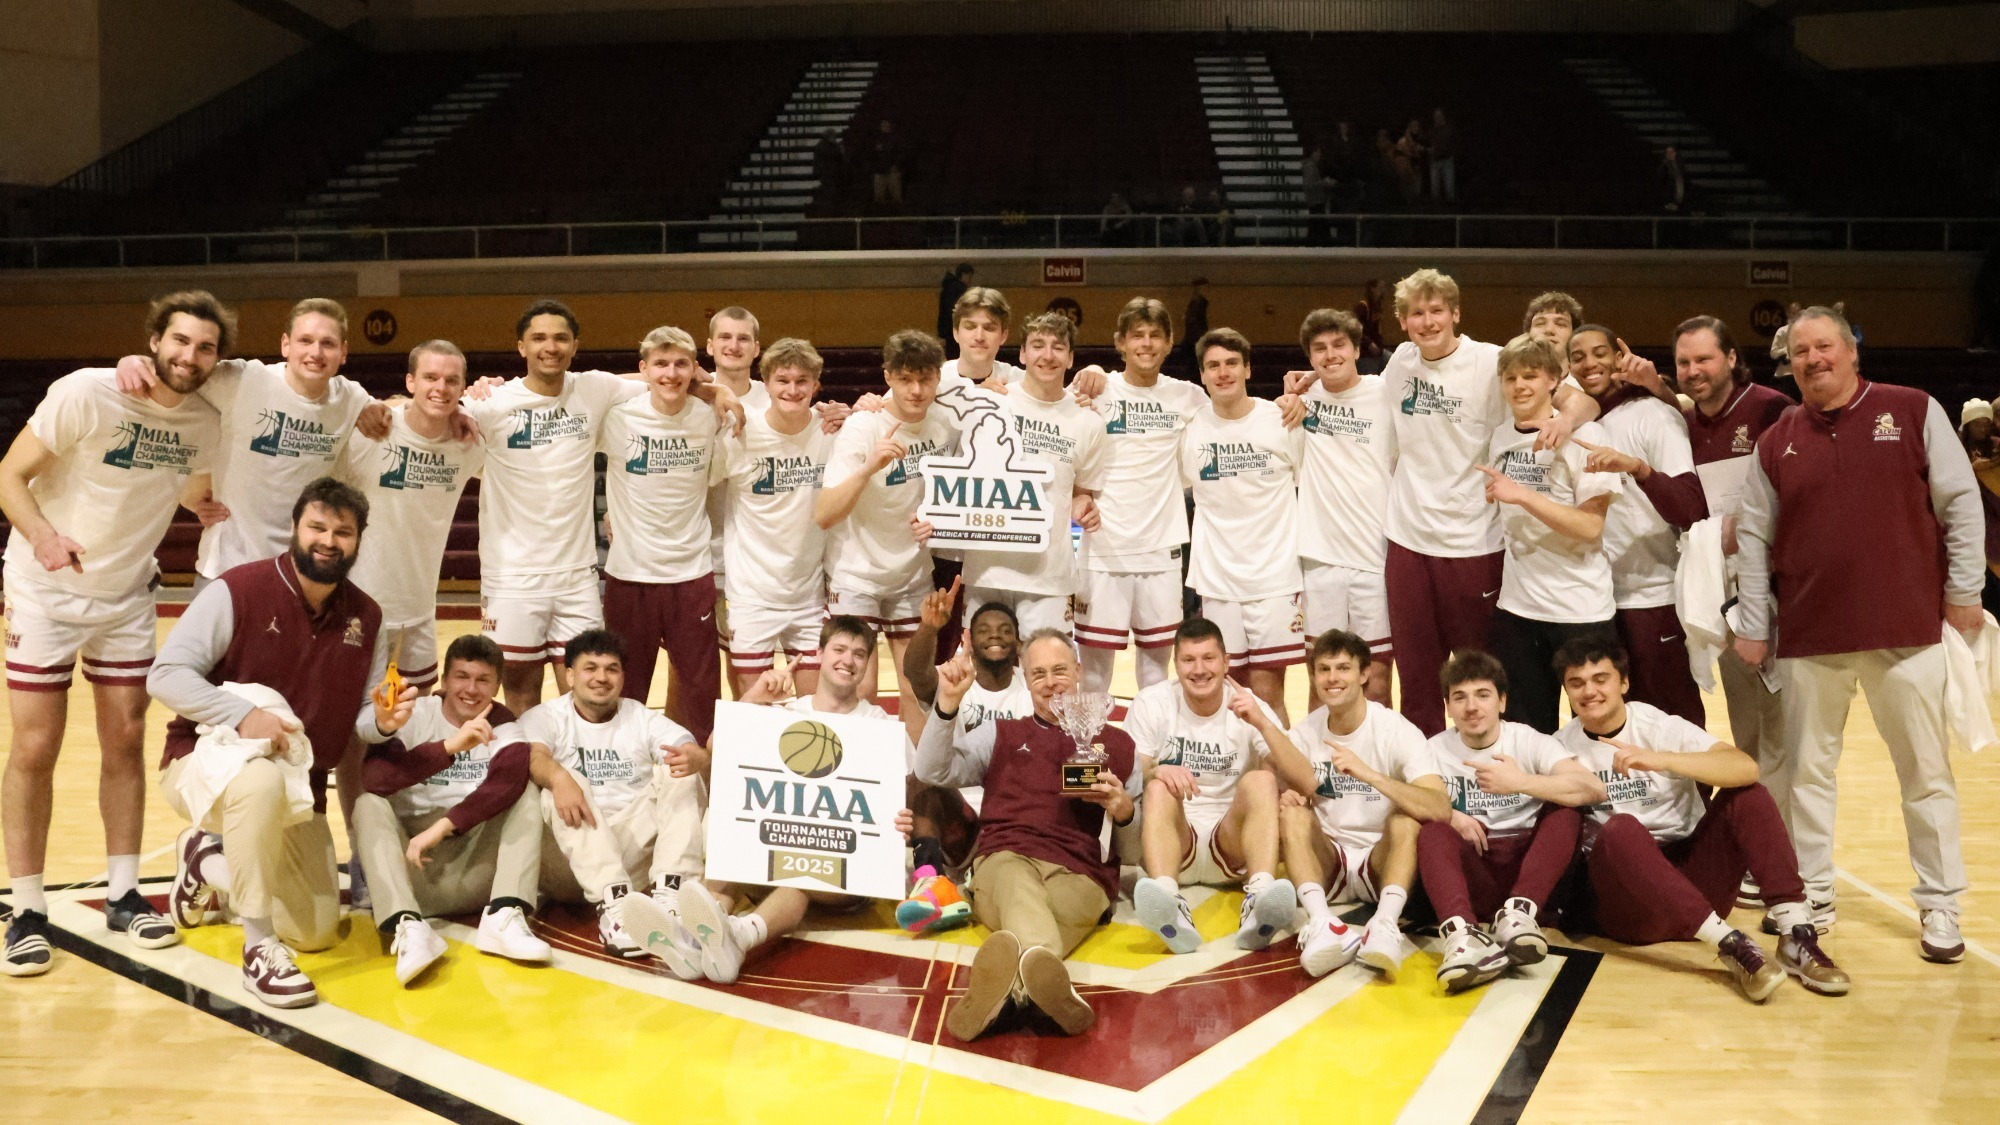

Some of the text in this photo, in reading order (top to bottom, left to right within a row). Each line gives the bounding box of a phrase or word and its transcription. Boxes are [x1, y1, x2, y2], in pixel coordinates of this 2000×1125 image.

[1046, 265, 1080, 277] Calvin
[1753, 267, 1786, 279] Calvin
[1754, 309, 1782, 326] 106
[366, 319, 393, 335] 104
[1127, 402, 1163, 413] MIAA
[1320, 404, 1355, 418] MIAA
[534, 408, 569, 421] MIAA
[1127, 413, 1179, 421] TOURNAMENT
[285, 417, 323, 434] MIAA
[533, 416, 588, 430] TOURNAMENT
[1024, 419, 1060, 436] MIAA
[1127, 420, 1174, 428] CHAMPIONS
[1319, 414, 1372, 429] TOURNAMENT
[140, 427, 180, 445] MIAA
[284, 431, 340, 444] TOURNAMENT
[533, 425, 583, 438] CHAMPIONS
[1872, 427, 1901, 435] CALVIN
[651, 438, 688, 450] MIAA
[1023, 431, 1076, 448] TOURNAMENT
[139, 442, 198, 457] TOURNAMENT
[281, 440, 332, 453] CHAMPIONS
[1022, 439, 1068, 454] CHAMPIONS
[1219, 443, 1254, 455] MIAA
[135, 451, 188, 465] CHAMPIONS
[409, 451, 445, 466] MIAA
[650, 448, 706, 459] TOURNAMENT
[1219, 453, 1272, 463] TOURNAMENT
[1509, 451, 1536, 464] MIAA
[649, 457, 699, 466] CHAMPIONS
[776, 456, 811, 470] MIAA
[1219, 461, 1266, 470] CHAMPIONS
[408, 464, 459, 475] TOURNAMENT
[1507, 464, 1551, 475] TOURNAMENT
[407, 473, 453, 483] CHAMPIONS
[931, 475, 1042, 511] MIAA
[965, 513, 1006, 528] 1888
[932, 530, 969, 538] AMERICA'S
[1185, 740, 1221, 754] MIAA
[586, 749, 620, 761] MIAA
[1184, 753, 1238, 764] TOURNAMENT
[1183, 761, 1231, 771] CHAMPIONS
[437, 770, 482, 779] HAMPIONS
[742, 776, 876, 825] MIAA
[1467, 797, 1520, 808] CHAMPIONS
[764, 821, 853, 840] TOURNAMENT
[769, 832, 848, 850] CHAMPIONS
[782, 856, 834, 875] 2025
